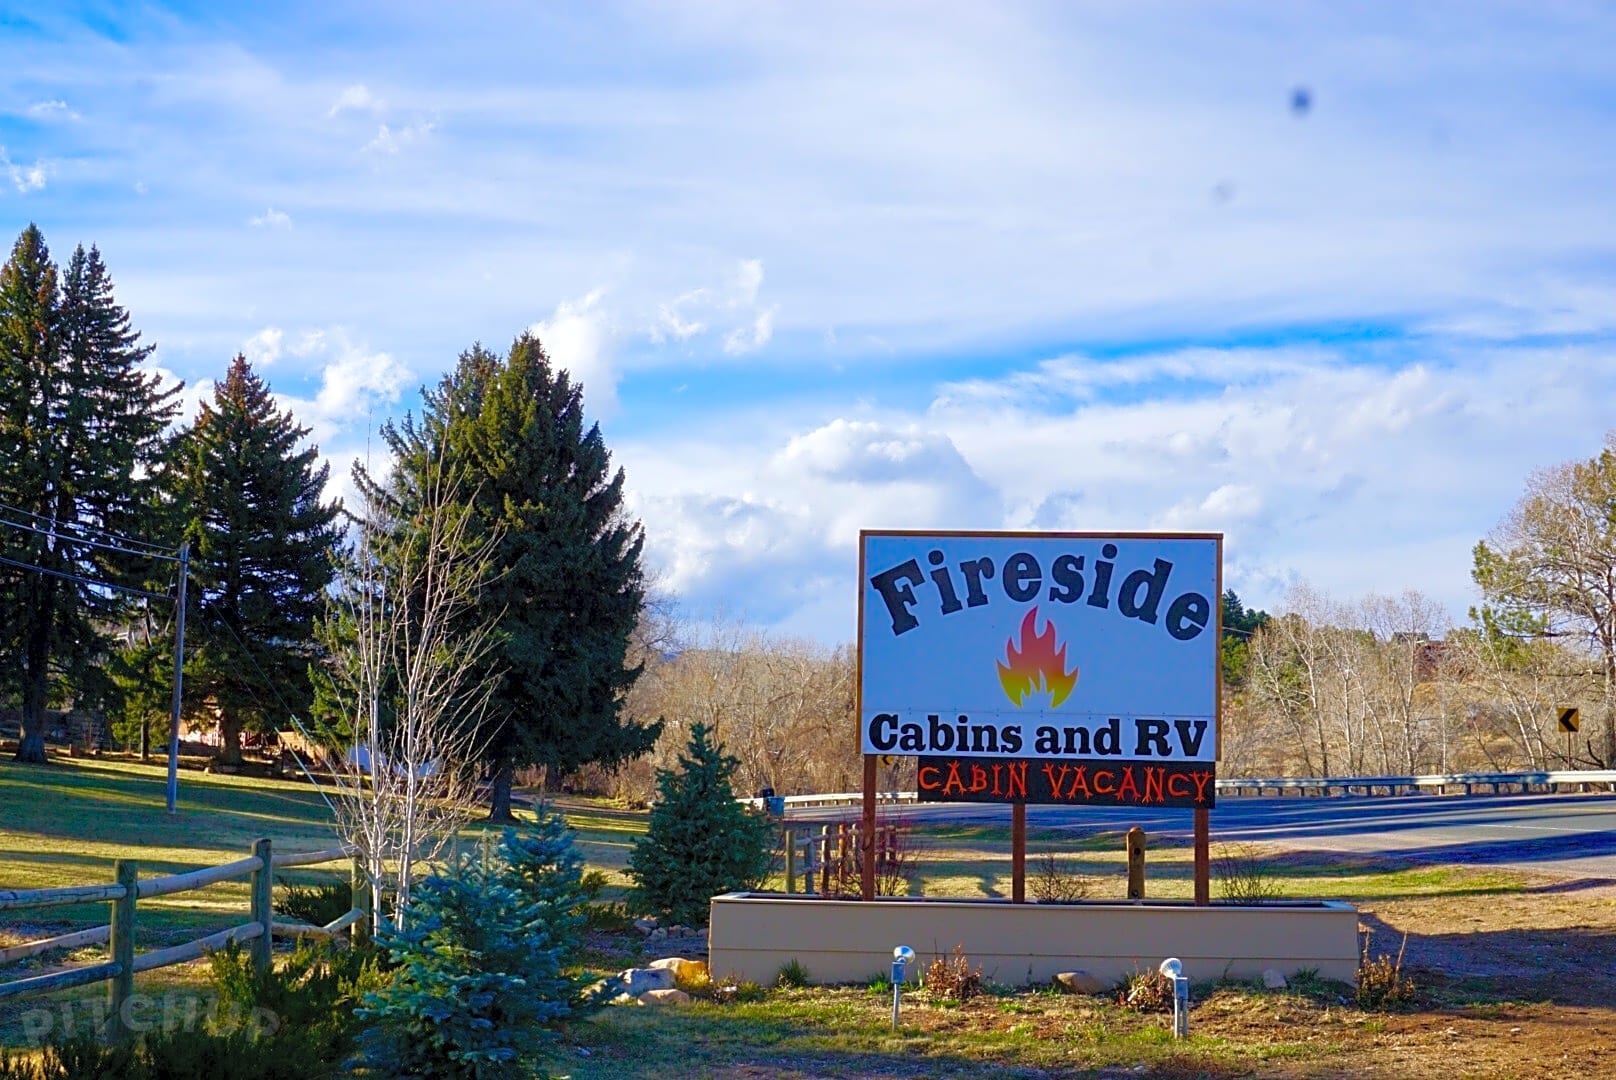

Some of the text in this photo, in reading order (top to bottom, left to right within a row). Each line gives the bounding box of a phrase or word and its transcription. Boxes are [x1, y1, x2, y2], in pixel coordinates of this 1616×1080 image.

[870, 544, 1210, 640] Fireside
[869, 714, 1208, 757] Cabins and RV
[918, 760, 1214, 803] CABIN VACANCY
